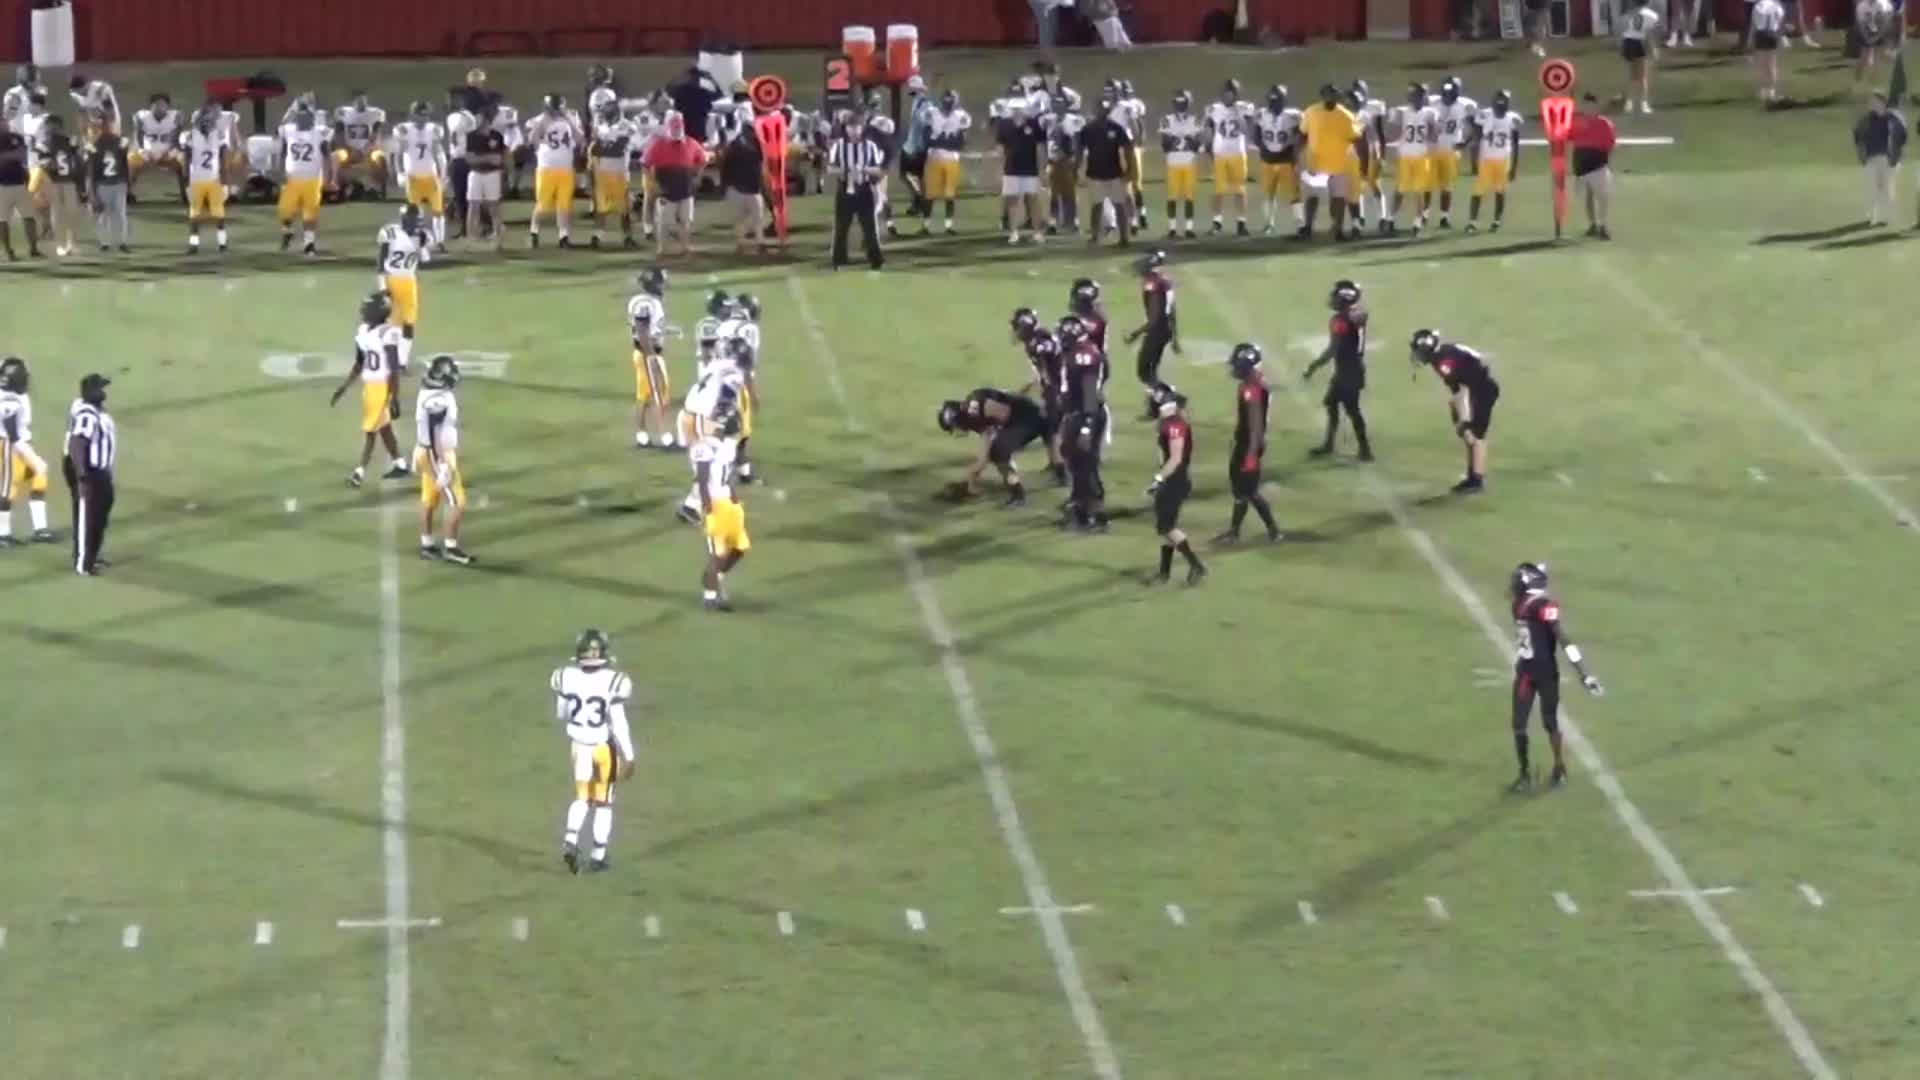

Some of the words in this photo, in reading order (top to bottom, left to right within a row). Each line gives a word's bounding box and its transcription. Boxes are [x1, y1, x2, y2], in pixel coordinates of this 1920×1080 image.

[827, 59, 849, 90] 2
[547, 130, 571, 150] 54
[200, 150, 214, 170] 2
[290, 142, 313, 162] 52
[415, 143, 428, 161] 7
[102, 150, 118, 177] 2
[564, 692, 608, 728] 23
